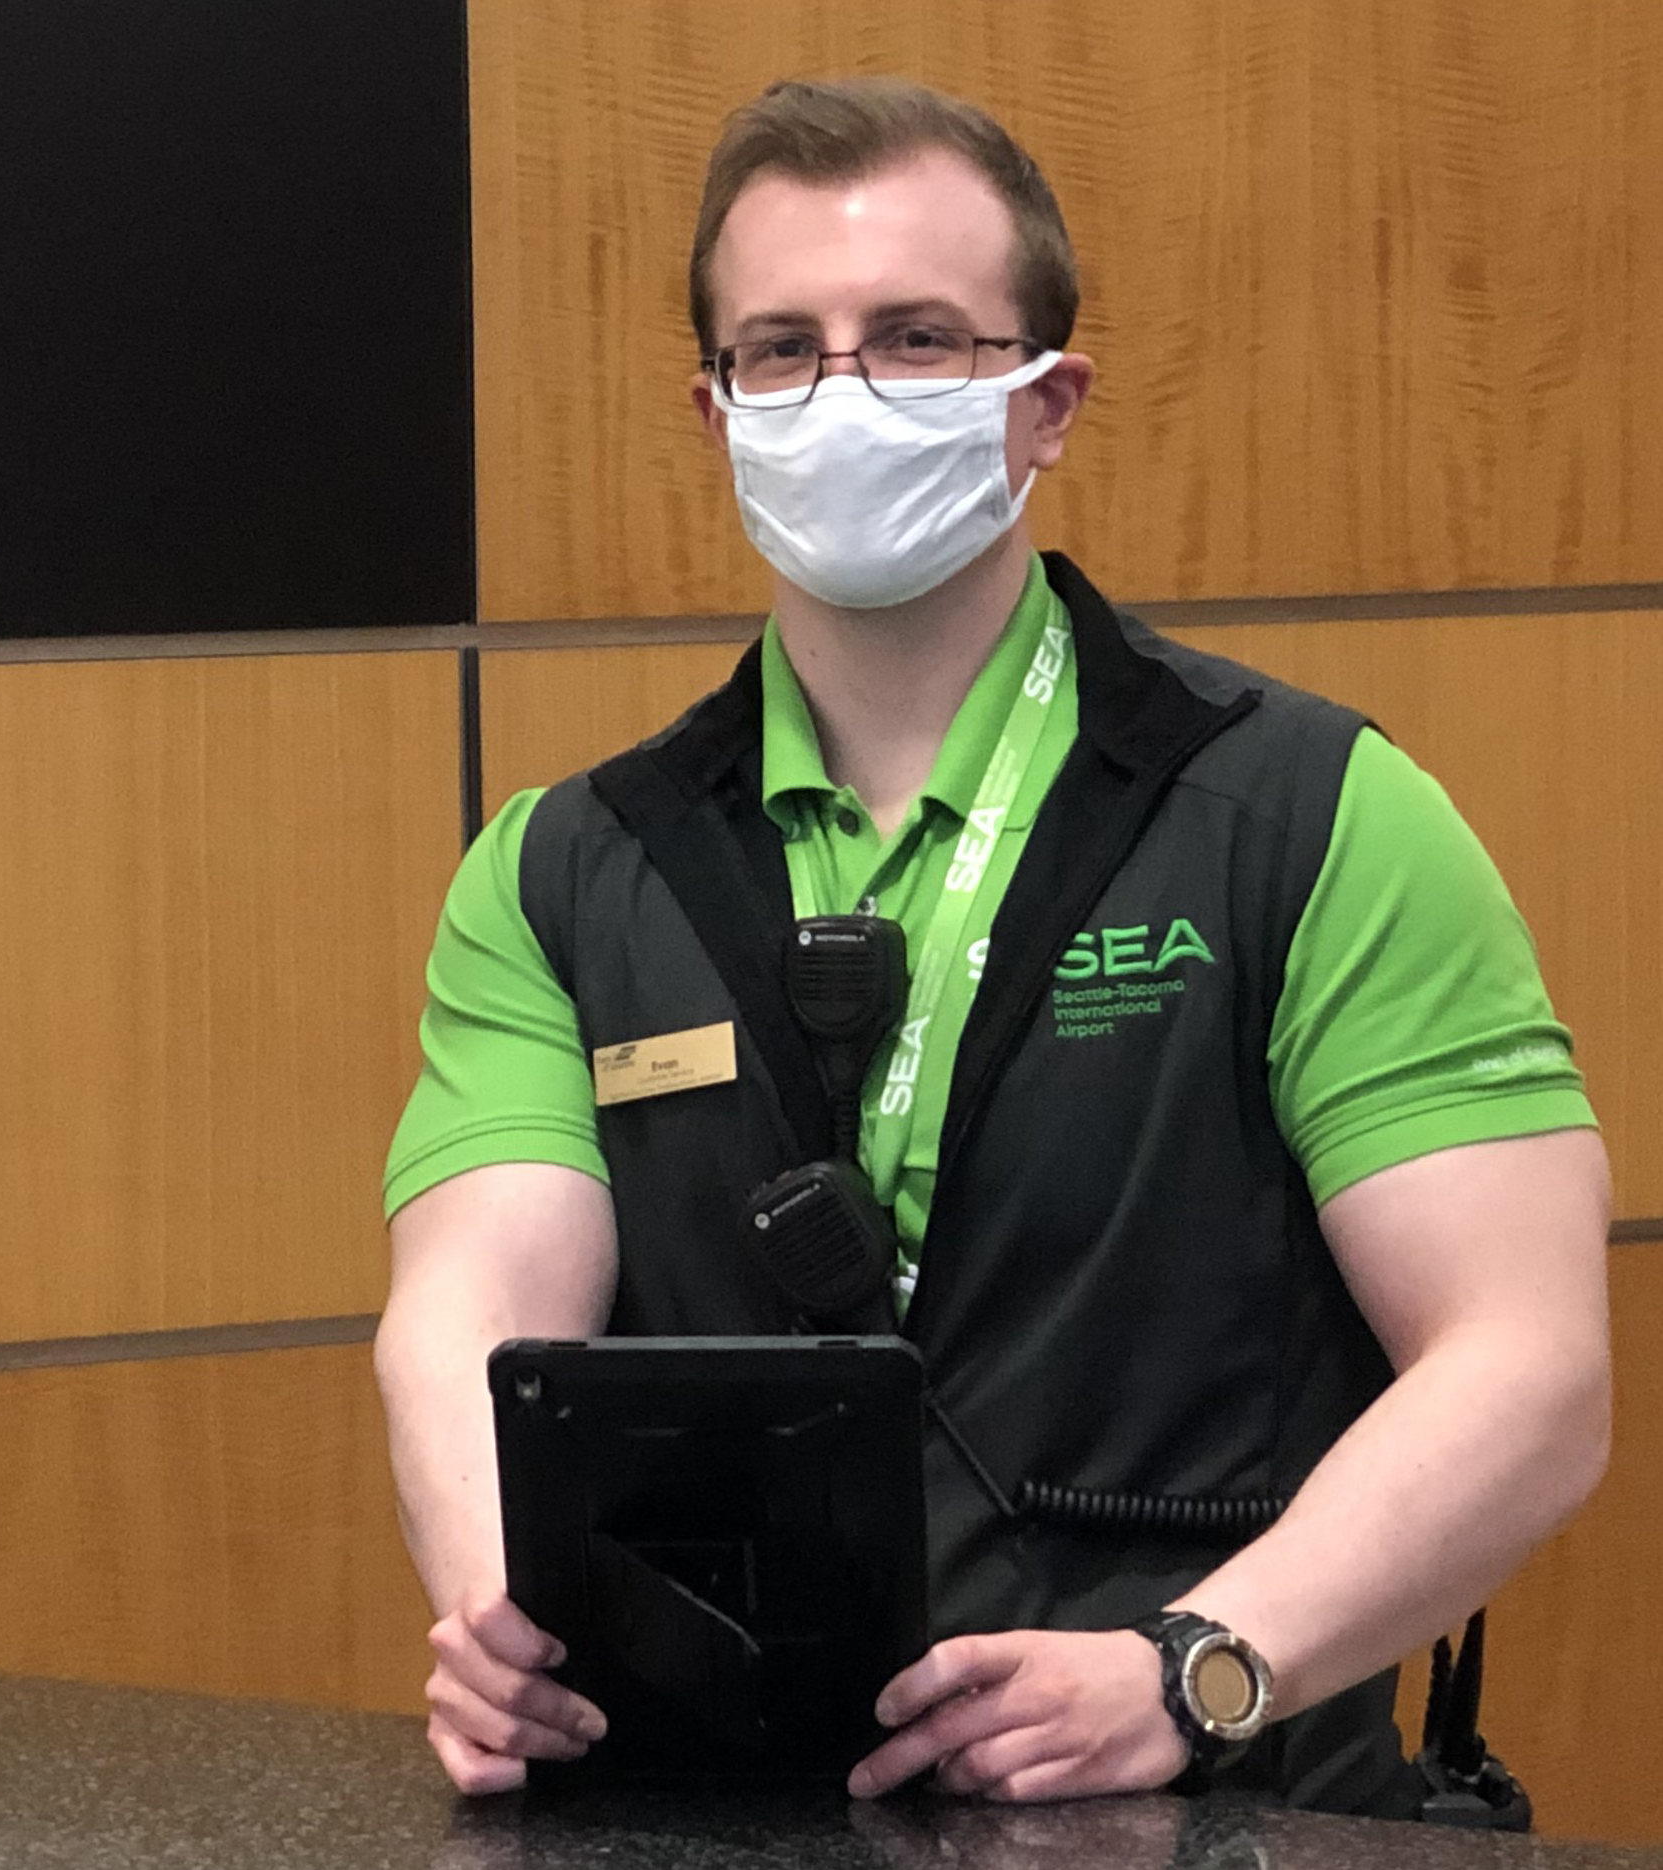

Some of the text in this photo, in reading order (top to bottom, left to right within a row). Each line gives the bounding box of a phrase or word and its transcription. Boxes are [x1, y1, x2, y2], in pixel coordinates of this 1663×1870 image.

[1024, 625, 1071, 704] SEA
[944, 805, 1005, 893] SEA
[1053, 917, 1216, 980] SEA
[1052, 979, 1186, 1004] Seattle-Tacoma
[1054, 998, 1162, 1020] International
[1055, 1021, 1115, 1039] Airport
[651, 1058, 679, 1073] Evan
[880, 1016, 930, 1116] SEA
